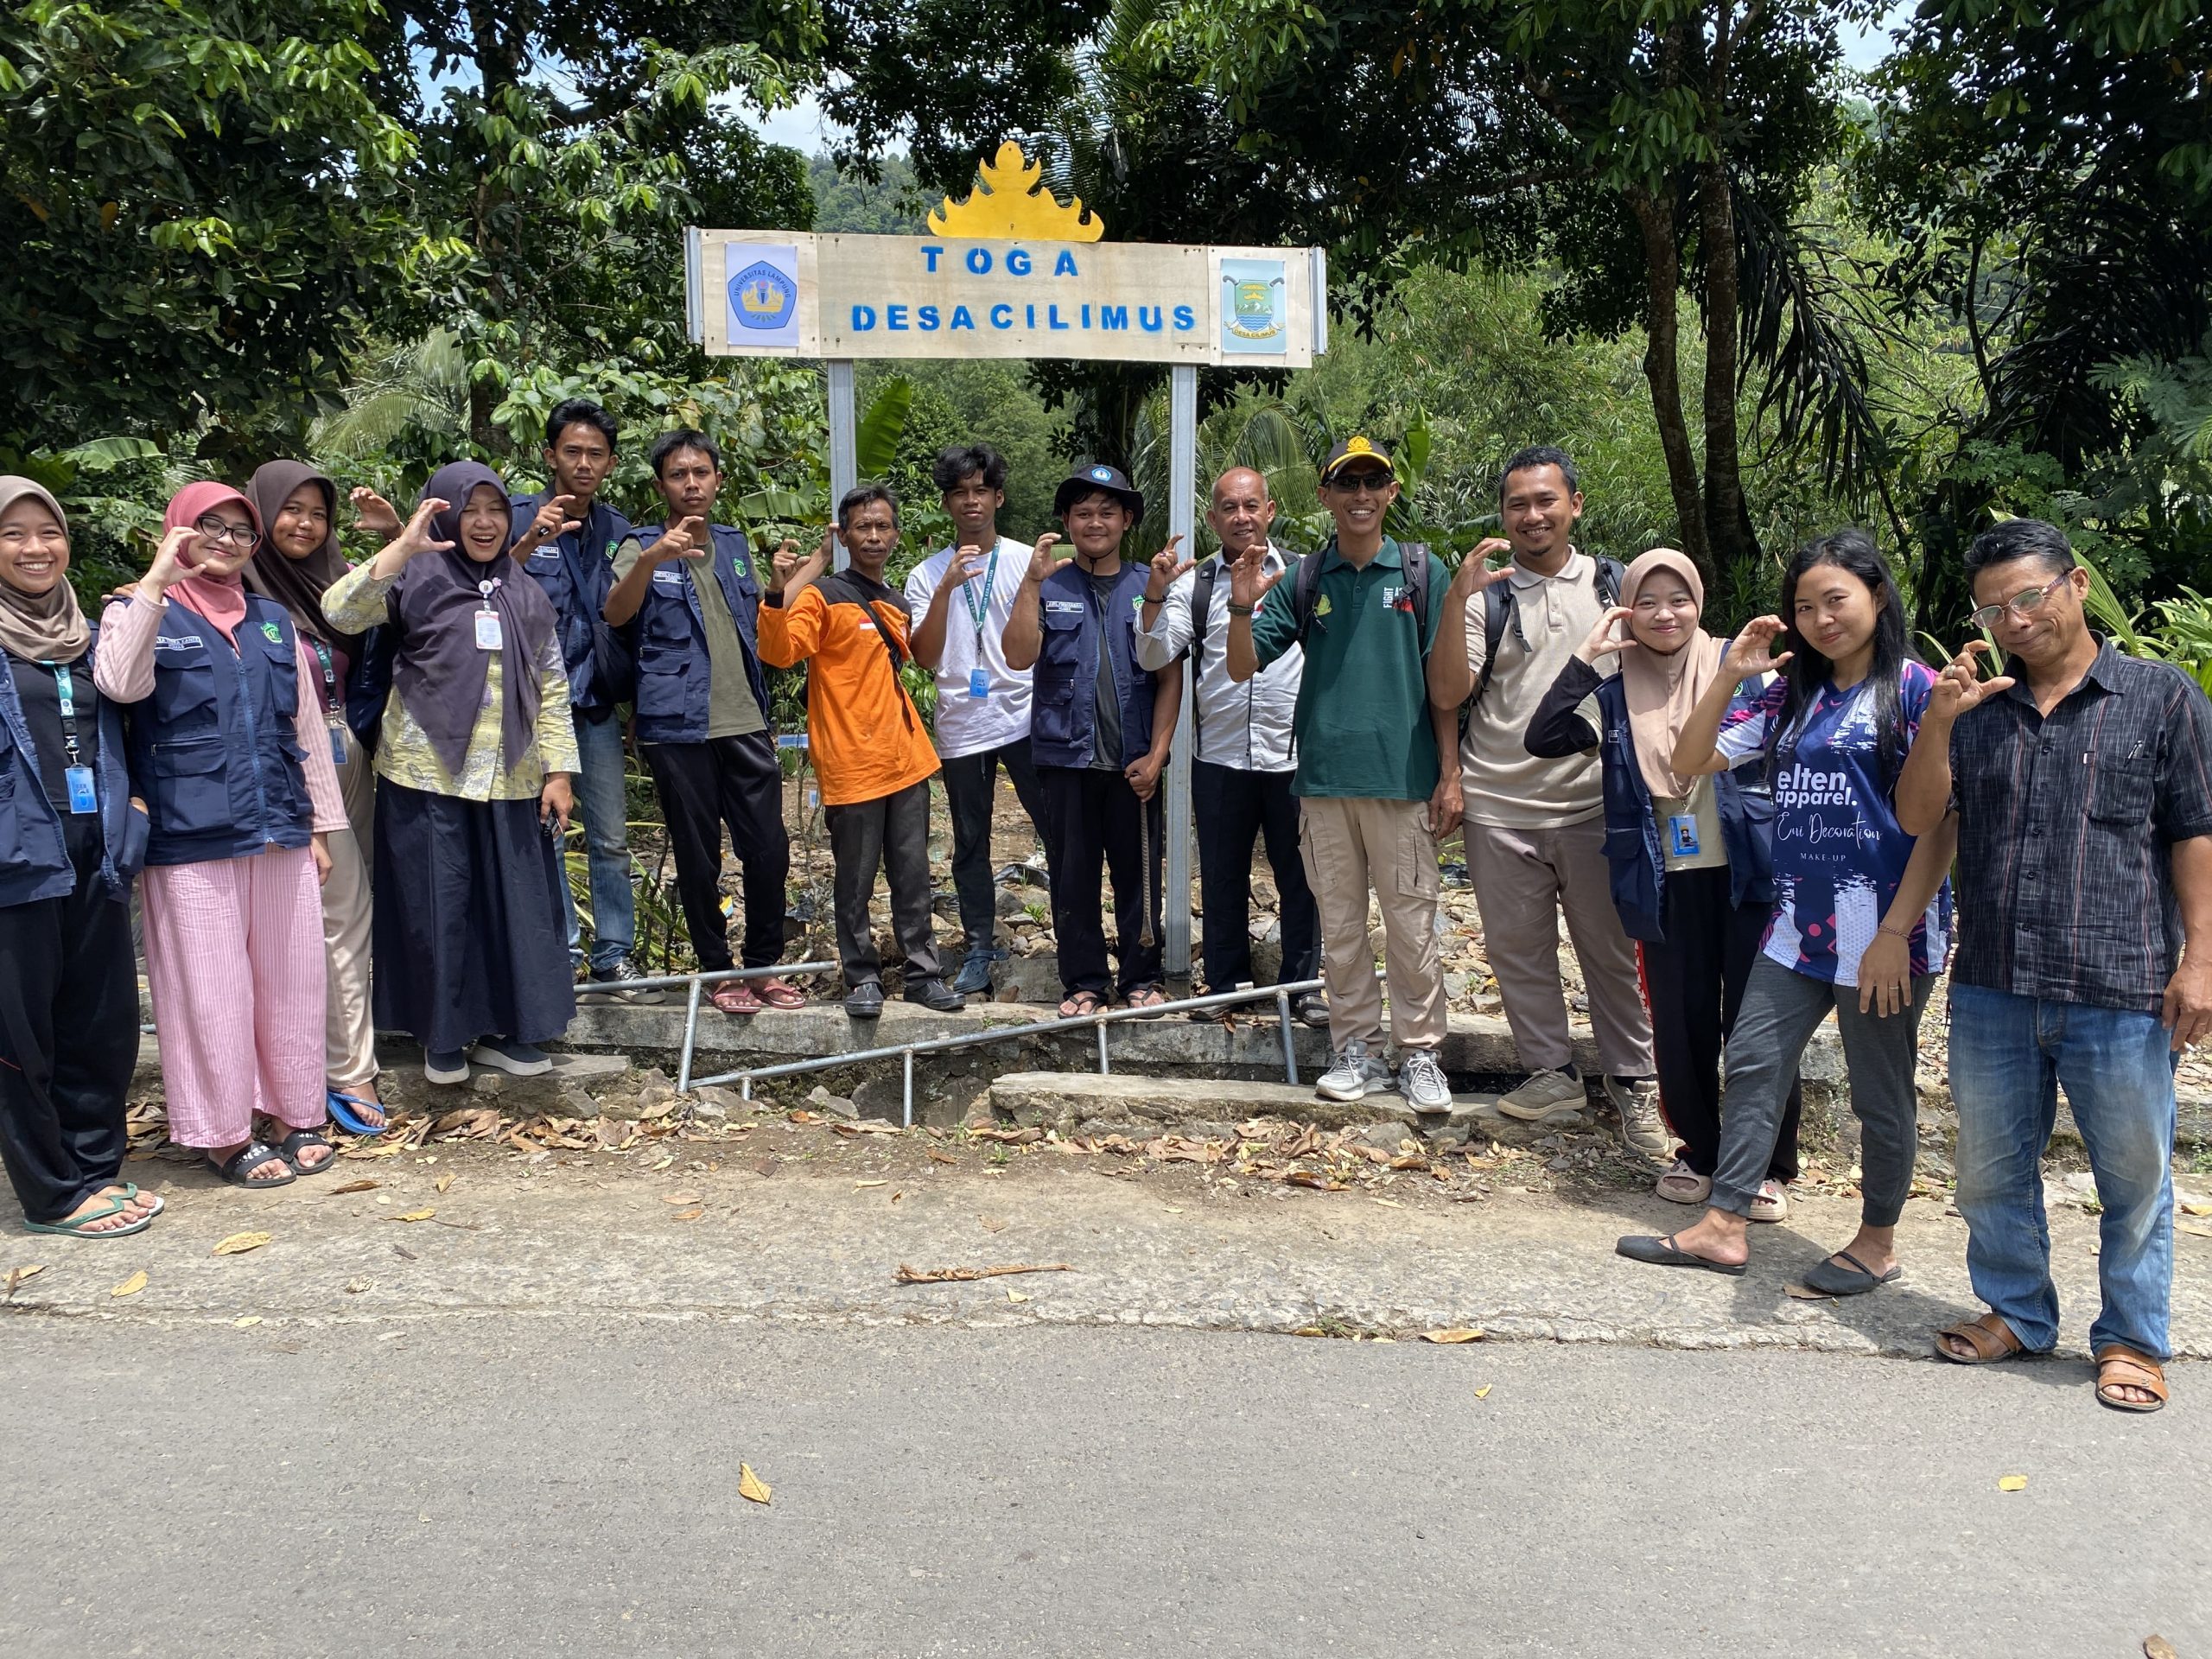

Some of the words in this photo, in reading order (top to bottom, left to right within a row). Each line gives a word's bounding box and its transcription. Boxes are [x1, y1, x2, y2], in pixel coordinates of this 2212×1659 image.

[920, 245, 1079, 276] TOGA
[734, 270, 766, 296] UNIVERSITAS
[767, 271, 791, 298] LAMPUNG
[852, 305, 976, 332] DESA
[989, 303, 1197, 332] CILIMUS
[1251, 329, 1276, 338] CILIMUS
[1382, 587, 1394, 608] FIGHT
[1777, 763, 1847, 791] elten
[1775, 786, 1858, 809] apparel.
[1808, 810, 1882, 850] Decoration
